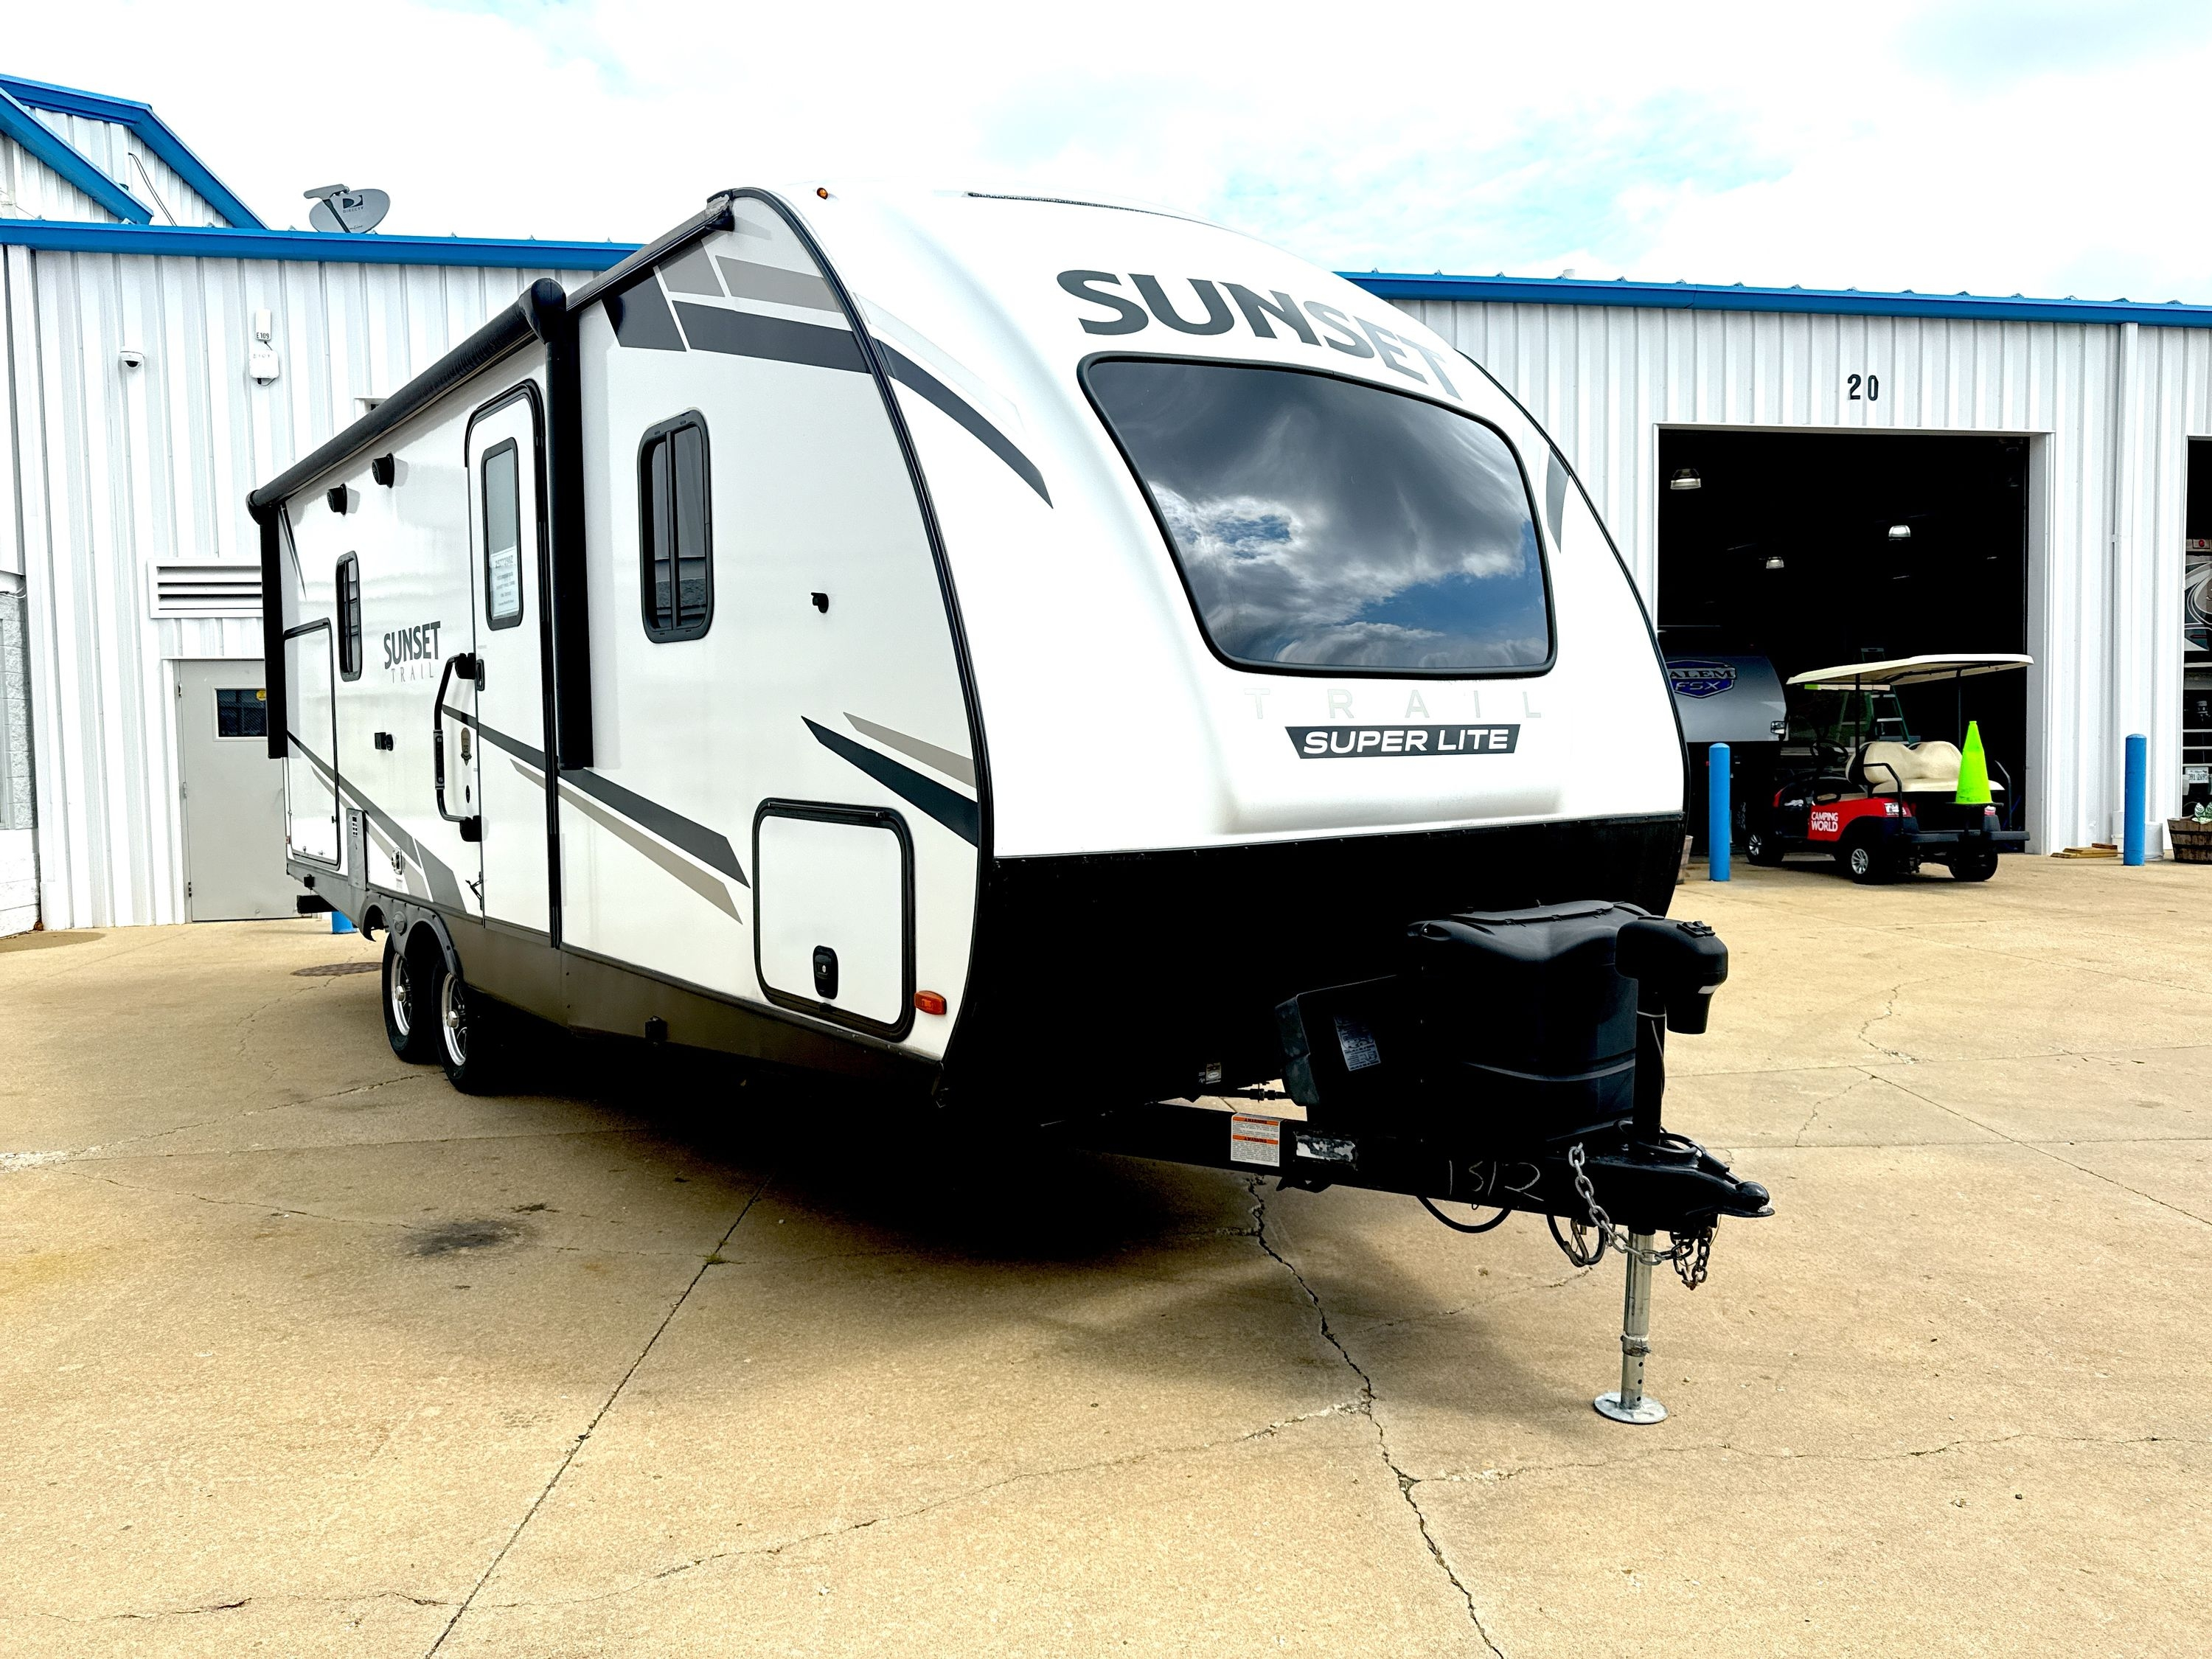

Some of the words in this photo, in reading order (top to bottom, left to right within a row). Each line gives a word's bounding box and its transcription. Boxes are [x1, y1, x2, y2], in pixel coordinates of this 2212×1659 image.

[1057, 269, 1464, 401] SUNSET
[1847, 373, 1879, 401] 20
[383, 620, 441, 669] SUNSET
[391, 661, 434, 684] TRAIL
[1669, 669, 1736, 678] ALEM
[1674, 681, 1721, 690] FSX
[1243, 688, 1543, 720] TRAIL
[1303, 730, 1429, 754] SUPER
[1437, 729, 1509, 751] LITE
[1811, 811, 1839, 821] CAMPING
[1811, 820, 1838, 832] WORLD
